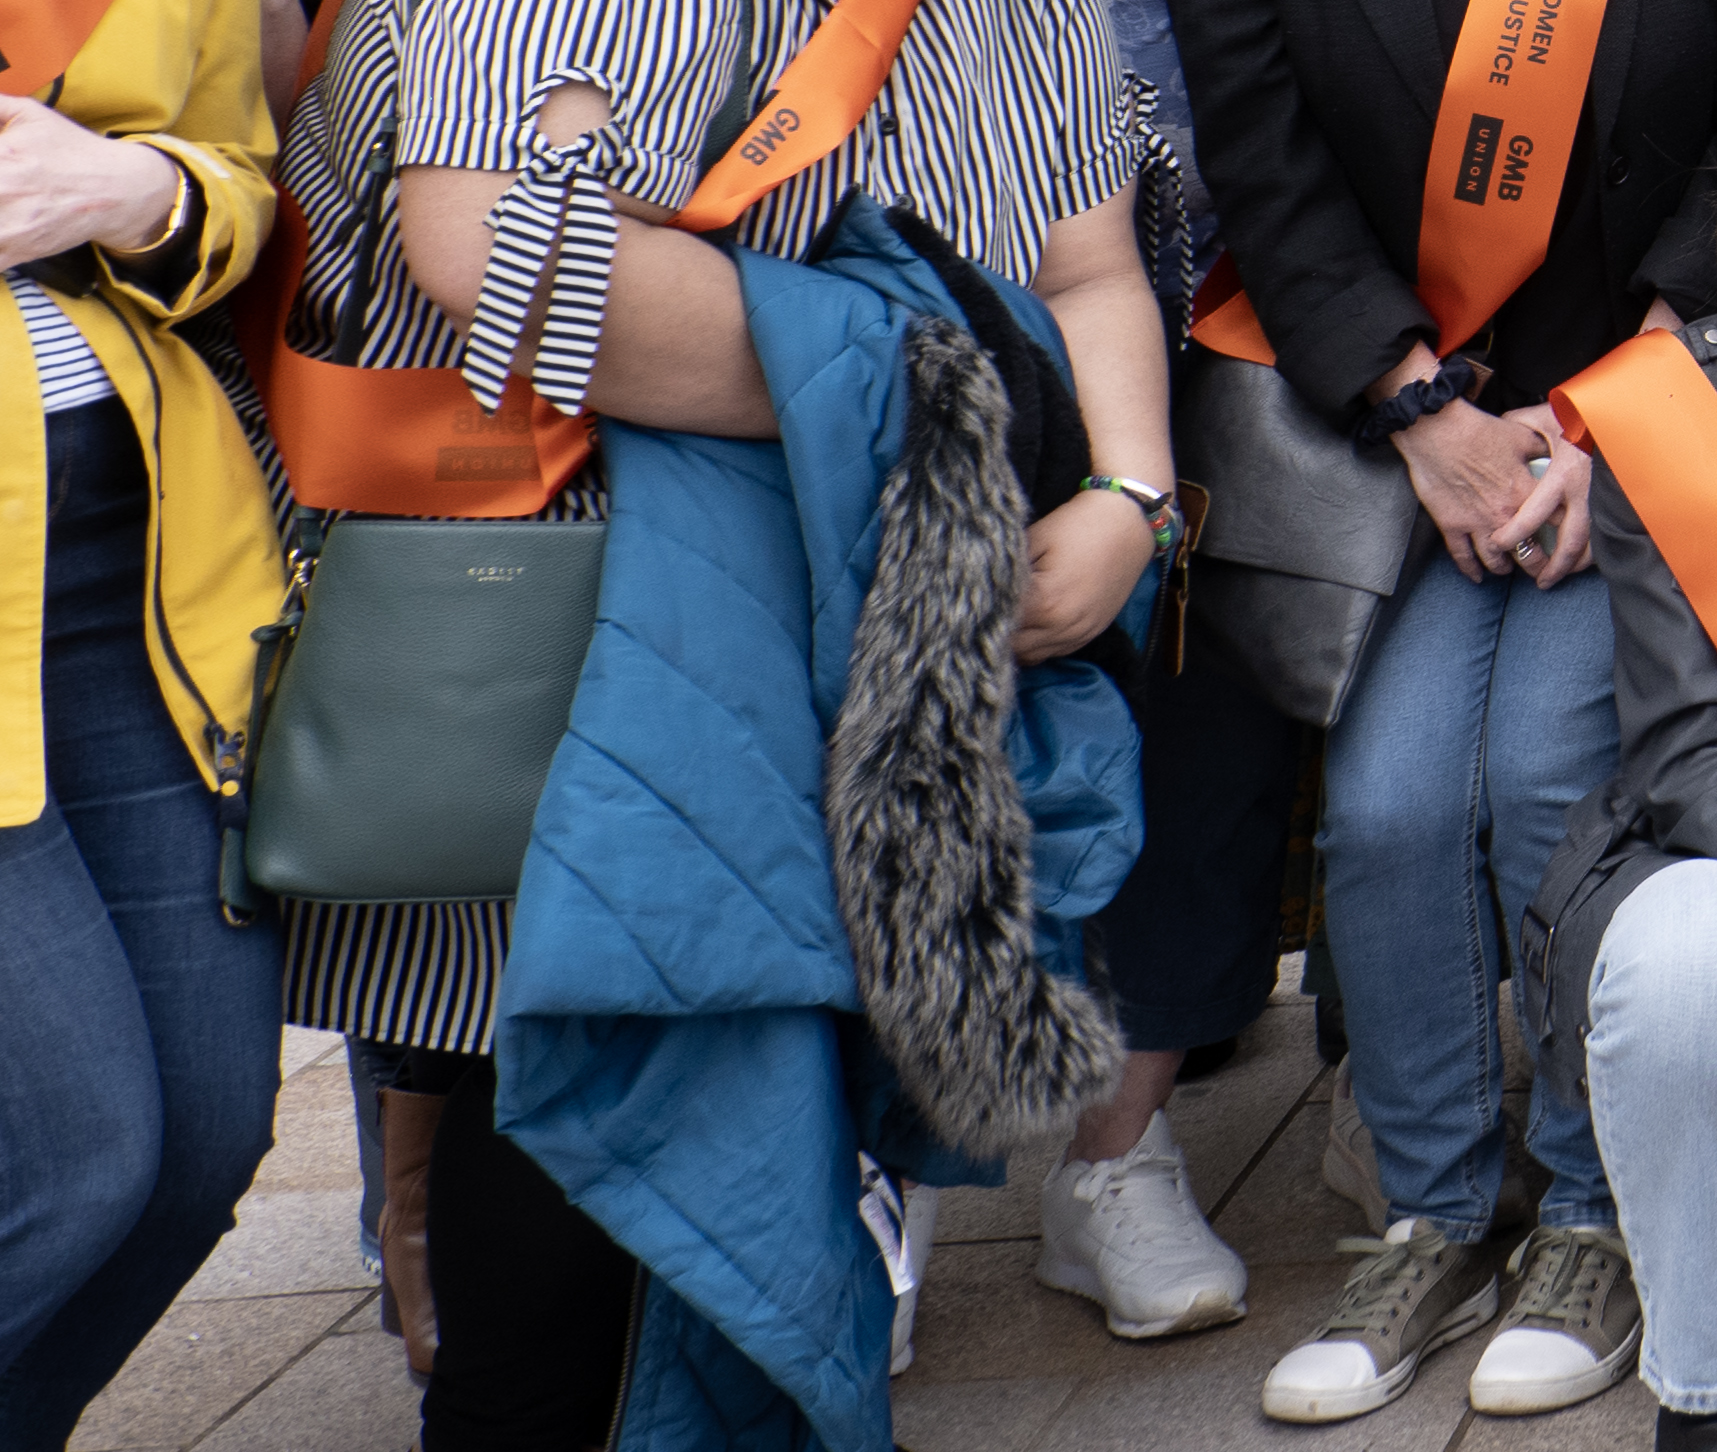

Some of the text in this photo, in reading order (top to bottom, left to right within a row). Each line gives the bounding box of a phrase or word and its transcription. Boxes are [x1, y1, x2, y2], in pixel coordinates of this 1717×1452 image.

[740, 109, 800, 166] GMB
[1466, 128, 1491, 192] UNION
[1497, 134, 1534, 202] GMB
